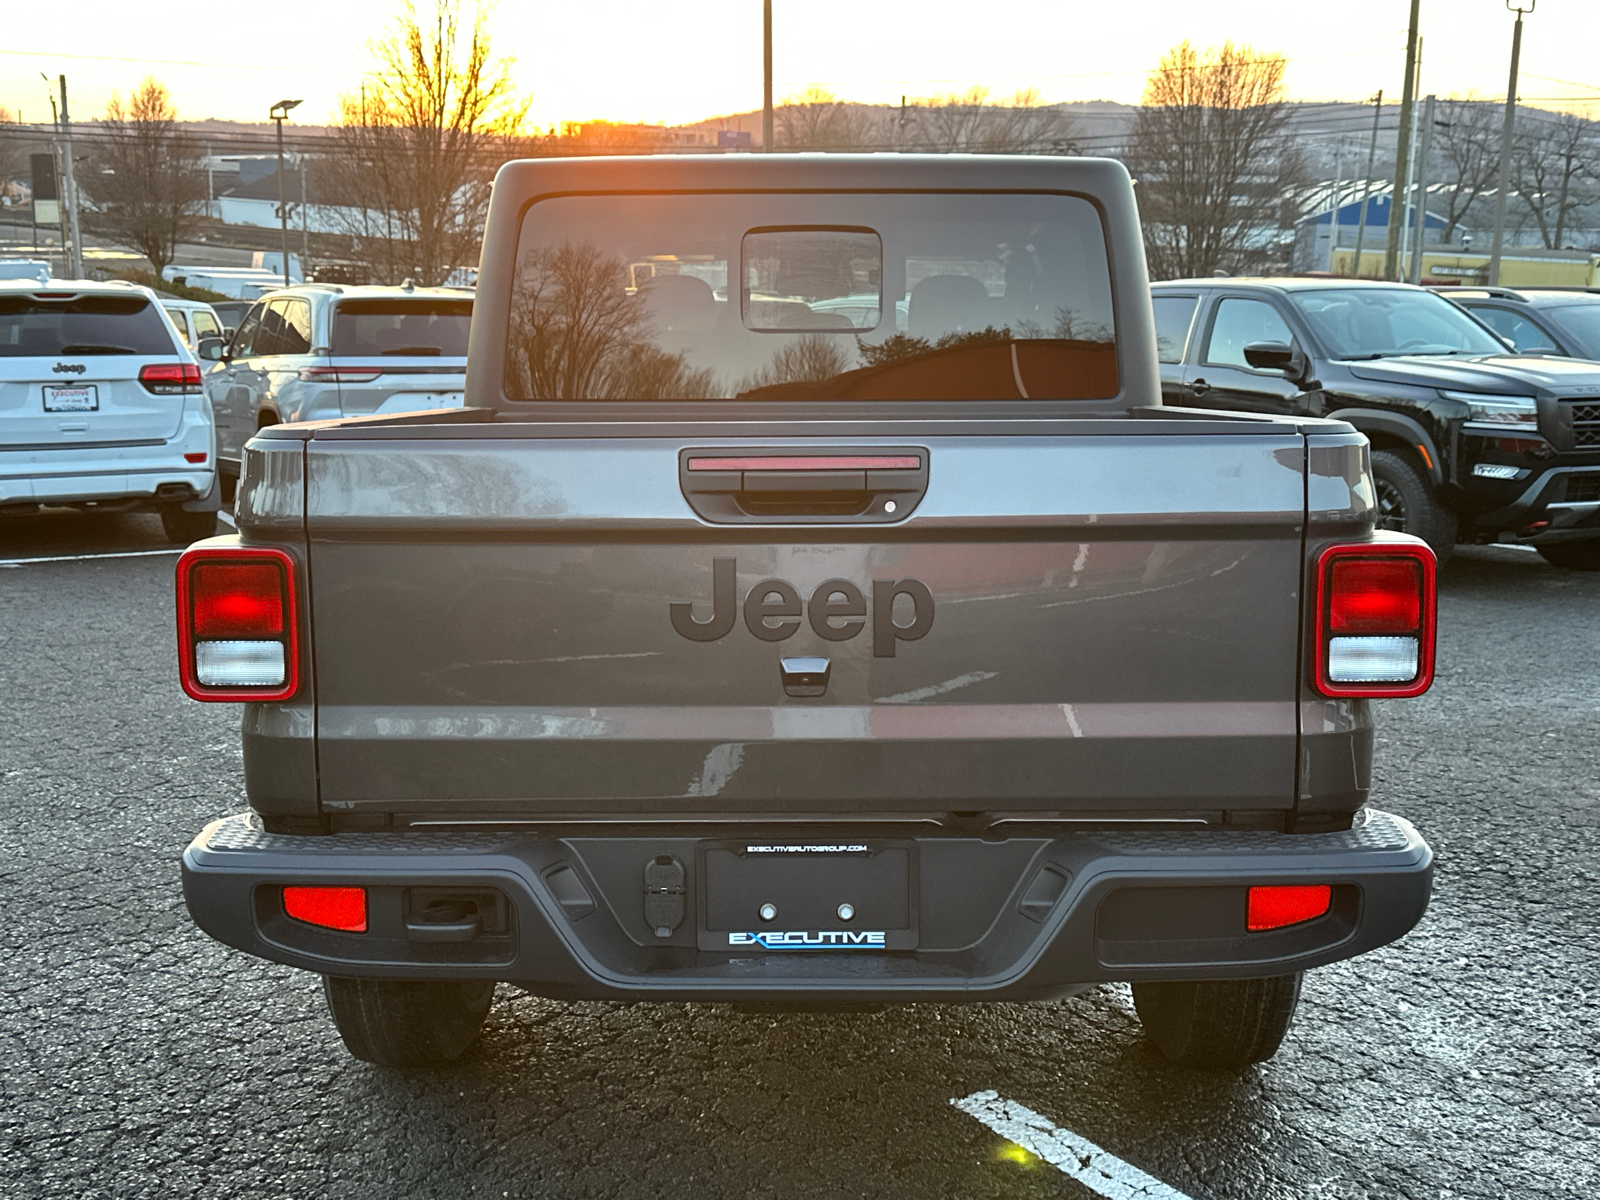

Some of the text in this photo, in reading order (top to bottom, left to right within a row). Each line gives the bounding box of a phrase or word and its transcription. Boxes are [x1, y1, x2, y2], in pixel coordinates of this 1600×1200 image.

[52, 362, 86, 375] Jeep
[669, 556, 935, 658] Jeep
[729, 931, 885, 945] EXECUTIVE
